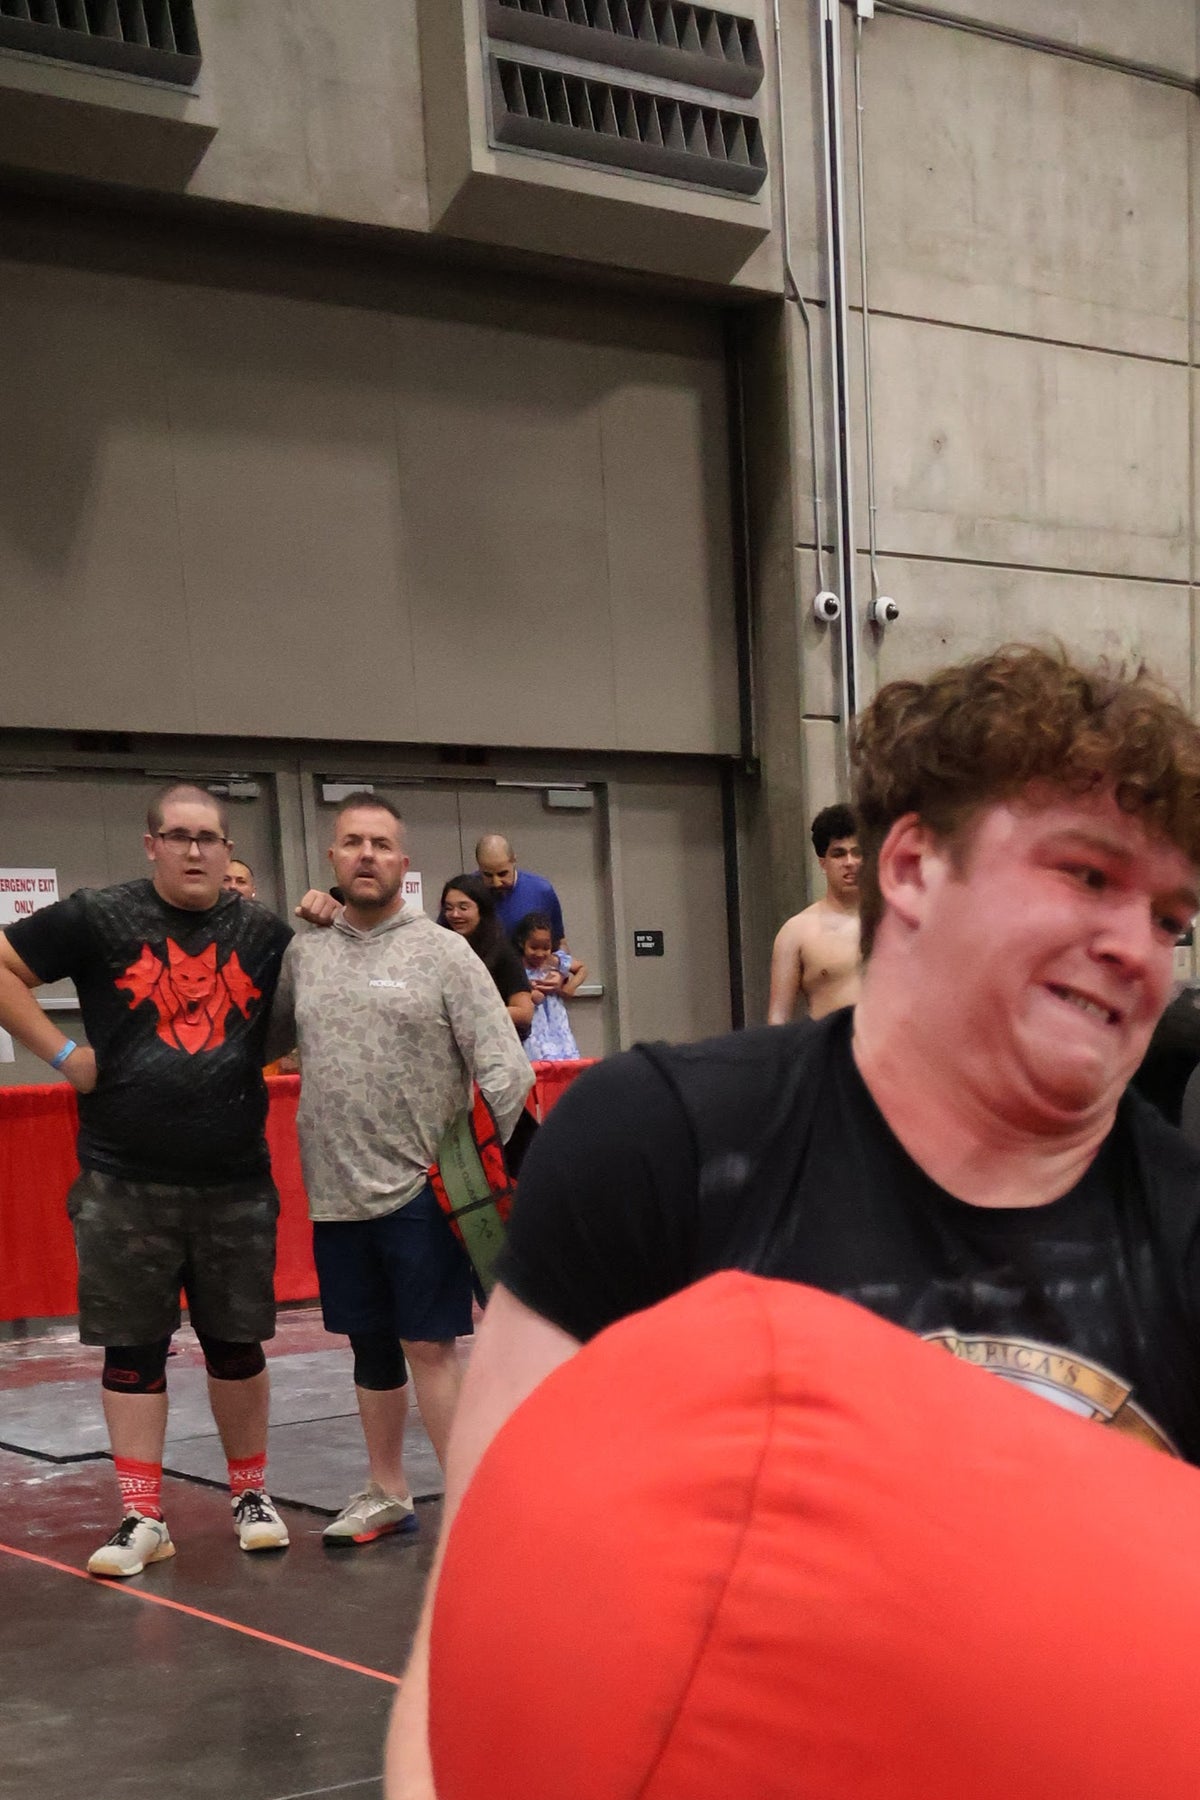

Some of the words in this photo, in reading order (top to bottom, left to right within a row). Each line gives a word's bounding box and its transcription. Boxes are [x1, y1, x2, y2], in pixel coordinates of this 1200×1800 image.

[38, 878, 55, 892] EXIT
[405, 881, 420, 894] EXIT
[14, 899, 34, 914] ONLY
[955, 1339, 1081, 1386] ERICA'S
